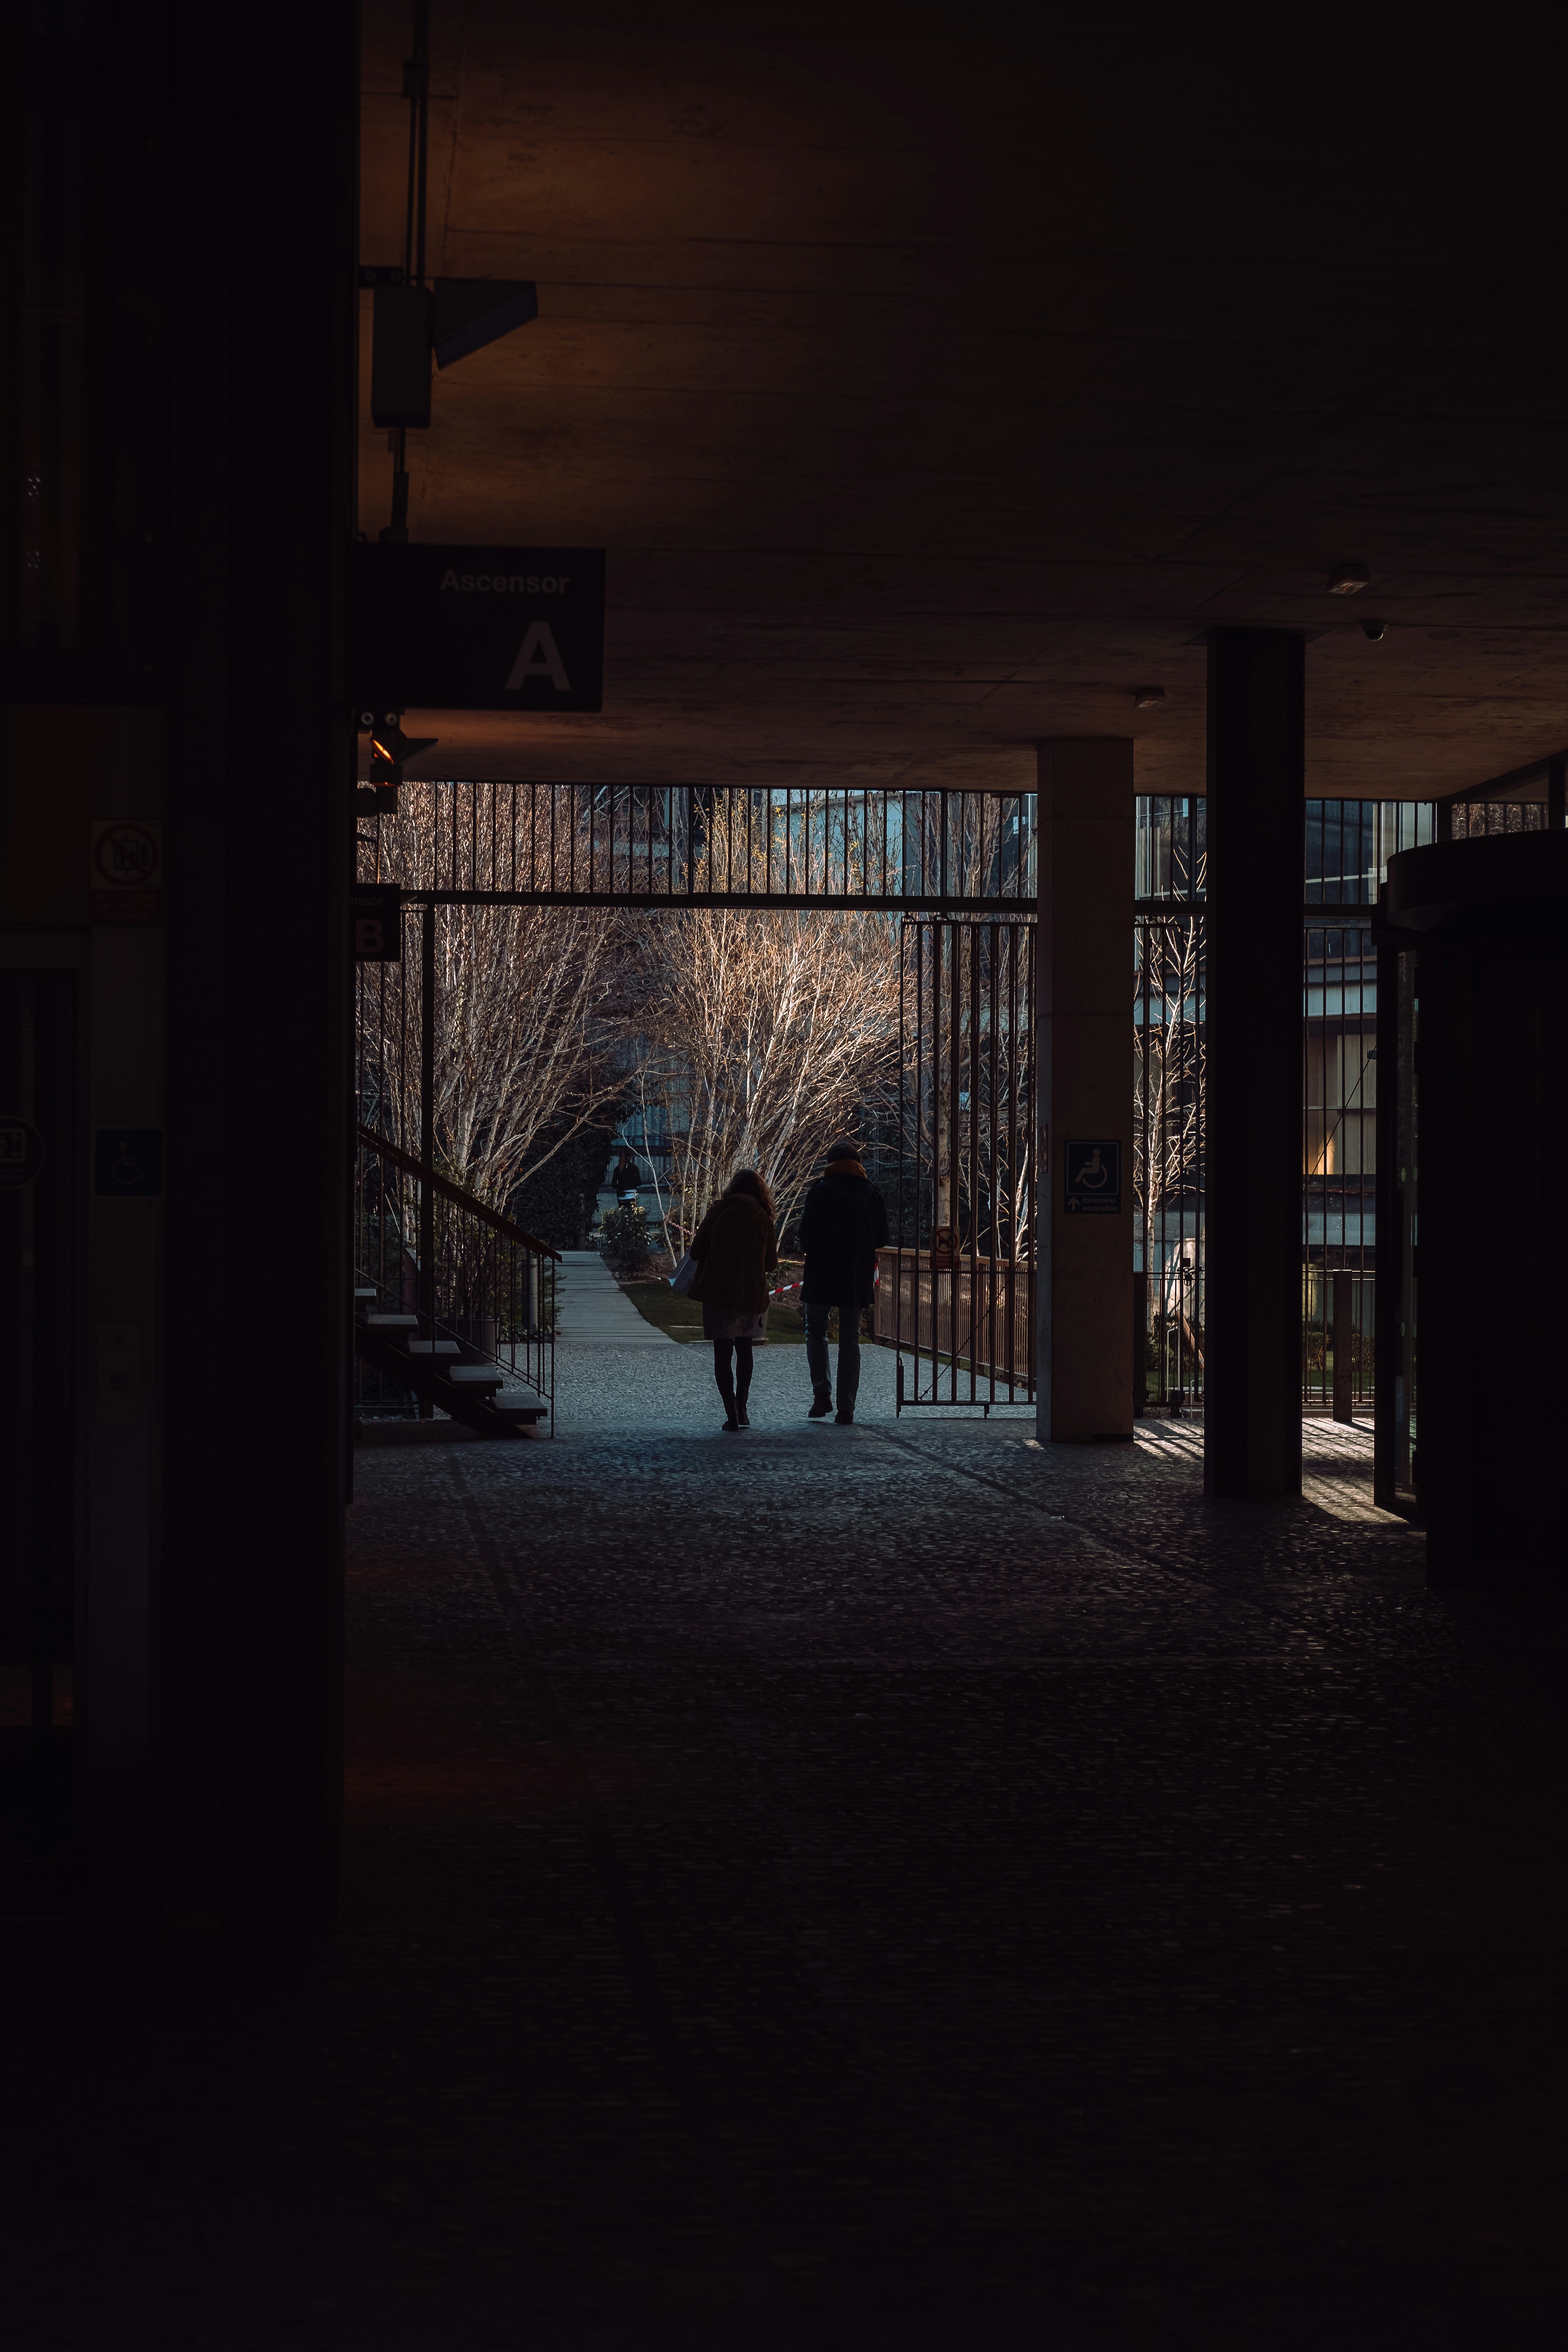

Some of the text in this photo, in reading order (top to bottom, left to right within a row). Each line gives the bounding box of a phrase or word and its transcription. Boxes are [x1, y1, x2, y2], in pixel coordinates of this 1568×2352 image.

[440, 568, 570, 594] Ascensor
[505, 620, 572, 692] A
[348, 897, 384, 906] ensor
[356, 919, 385, 953] B
